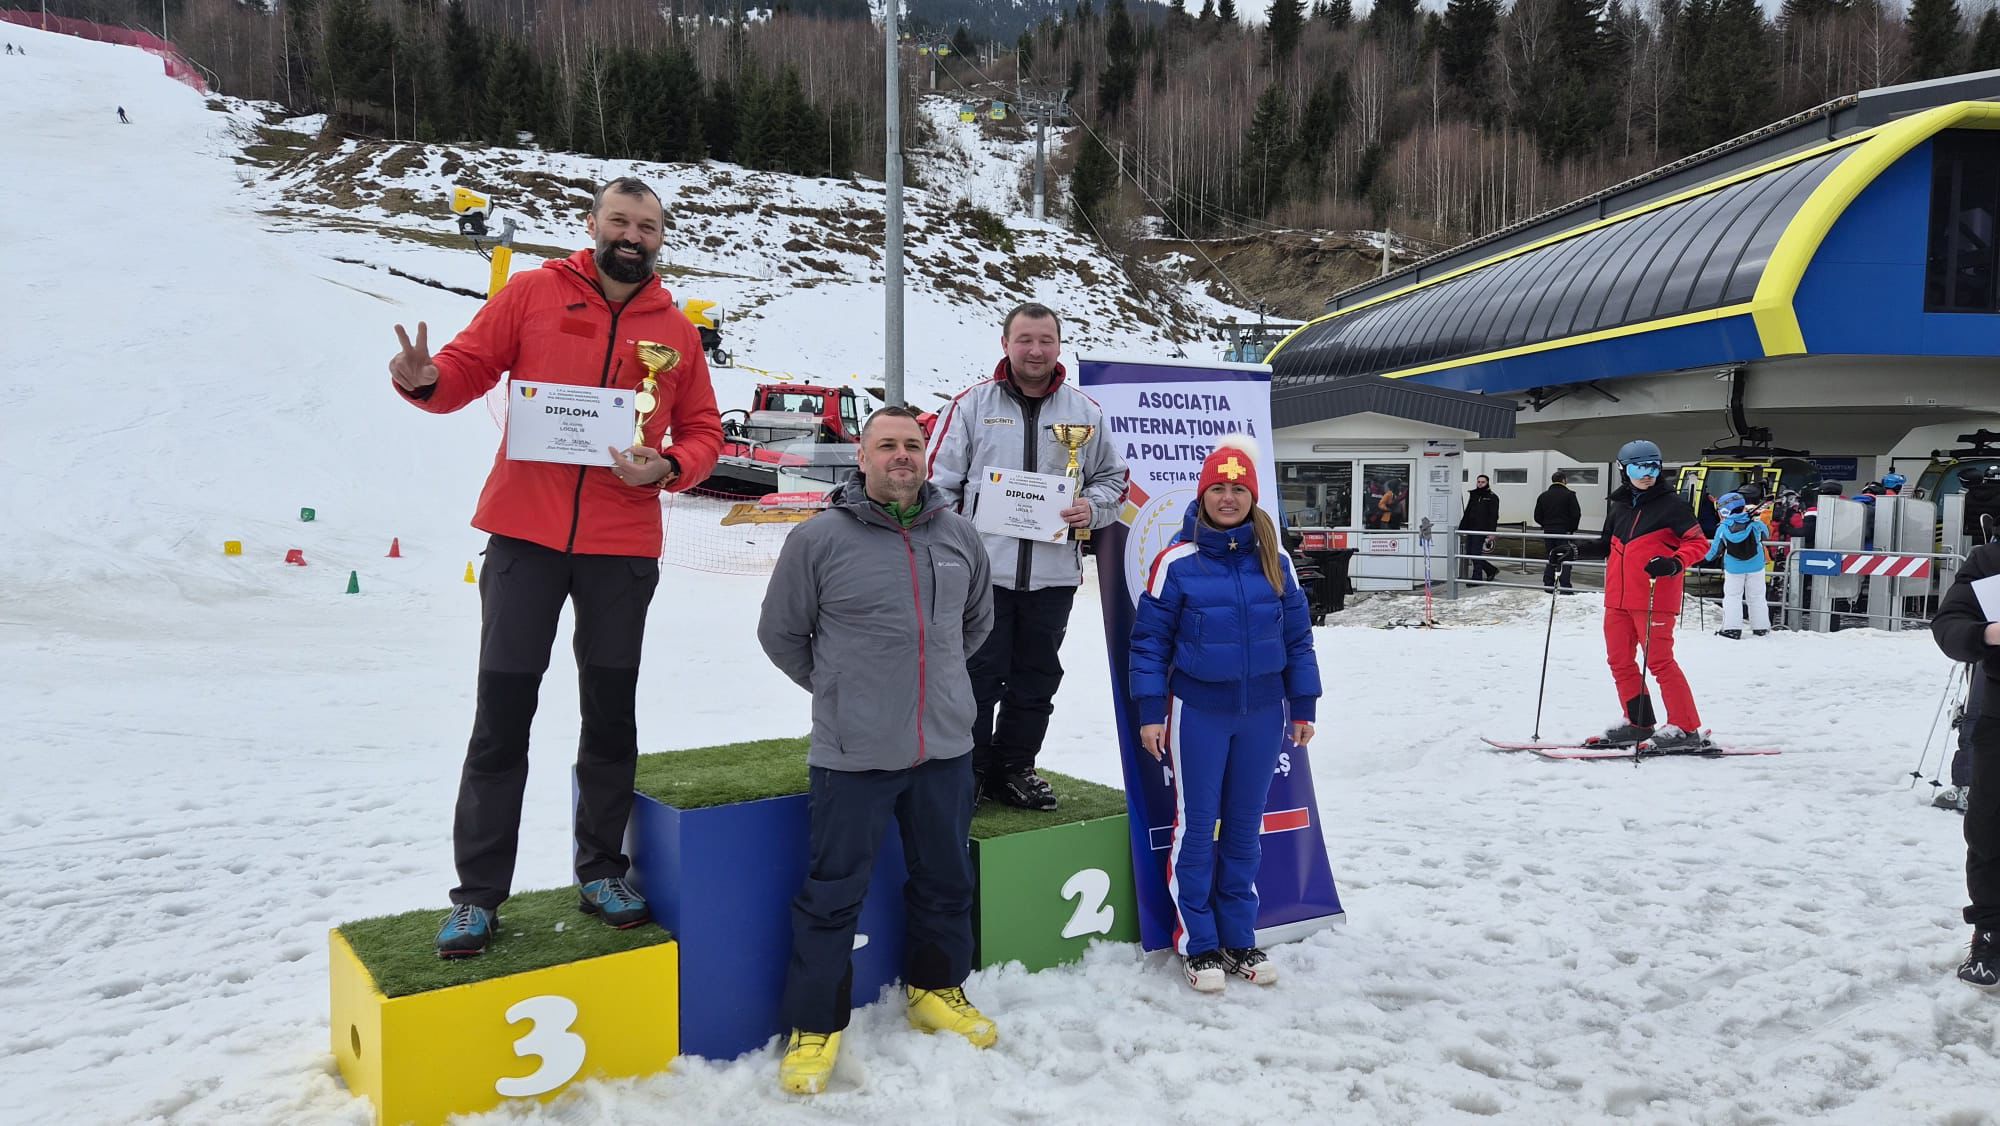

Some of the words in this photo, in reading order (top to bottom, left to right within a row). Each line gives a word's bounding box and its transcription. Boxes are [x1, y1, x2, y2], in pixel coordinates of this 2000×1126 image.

[545, 405, 599, 418] DIPLOMA
[1138, 391, 1231, 414] ASOCIAȚIA
[984, 417, 1015, 425] DESCENTE
[1126, 442, 1138, 460] A
[1141, 443, 1217, 465] POLITIȘT
[1149, 471, 1186, 484] SECȚIA
[1005, 489, 1046, 501] DIPLOMA
[1060, 868, 1115, 939] 2
[495, 995, 586, 1096] 3
